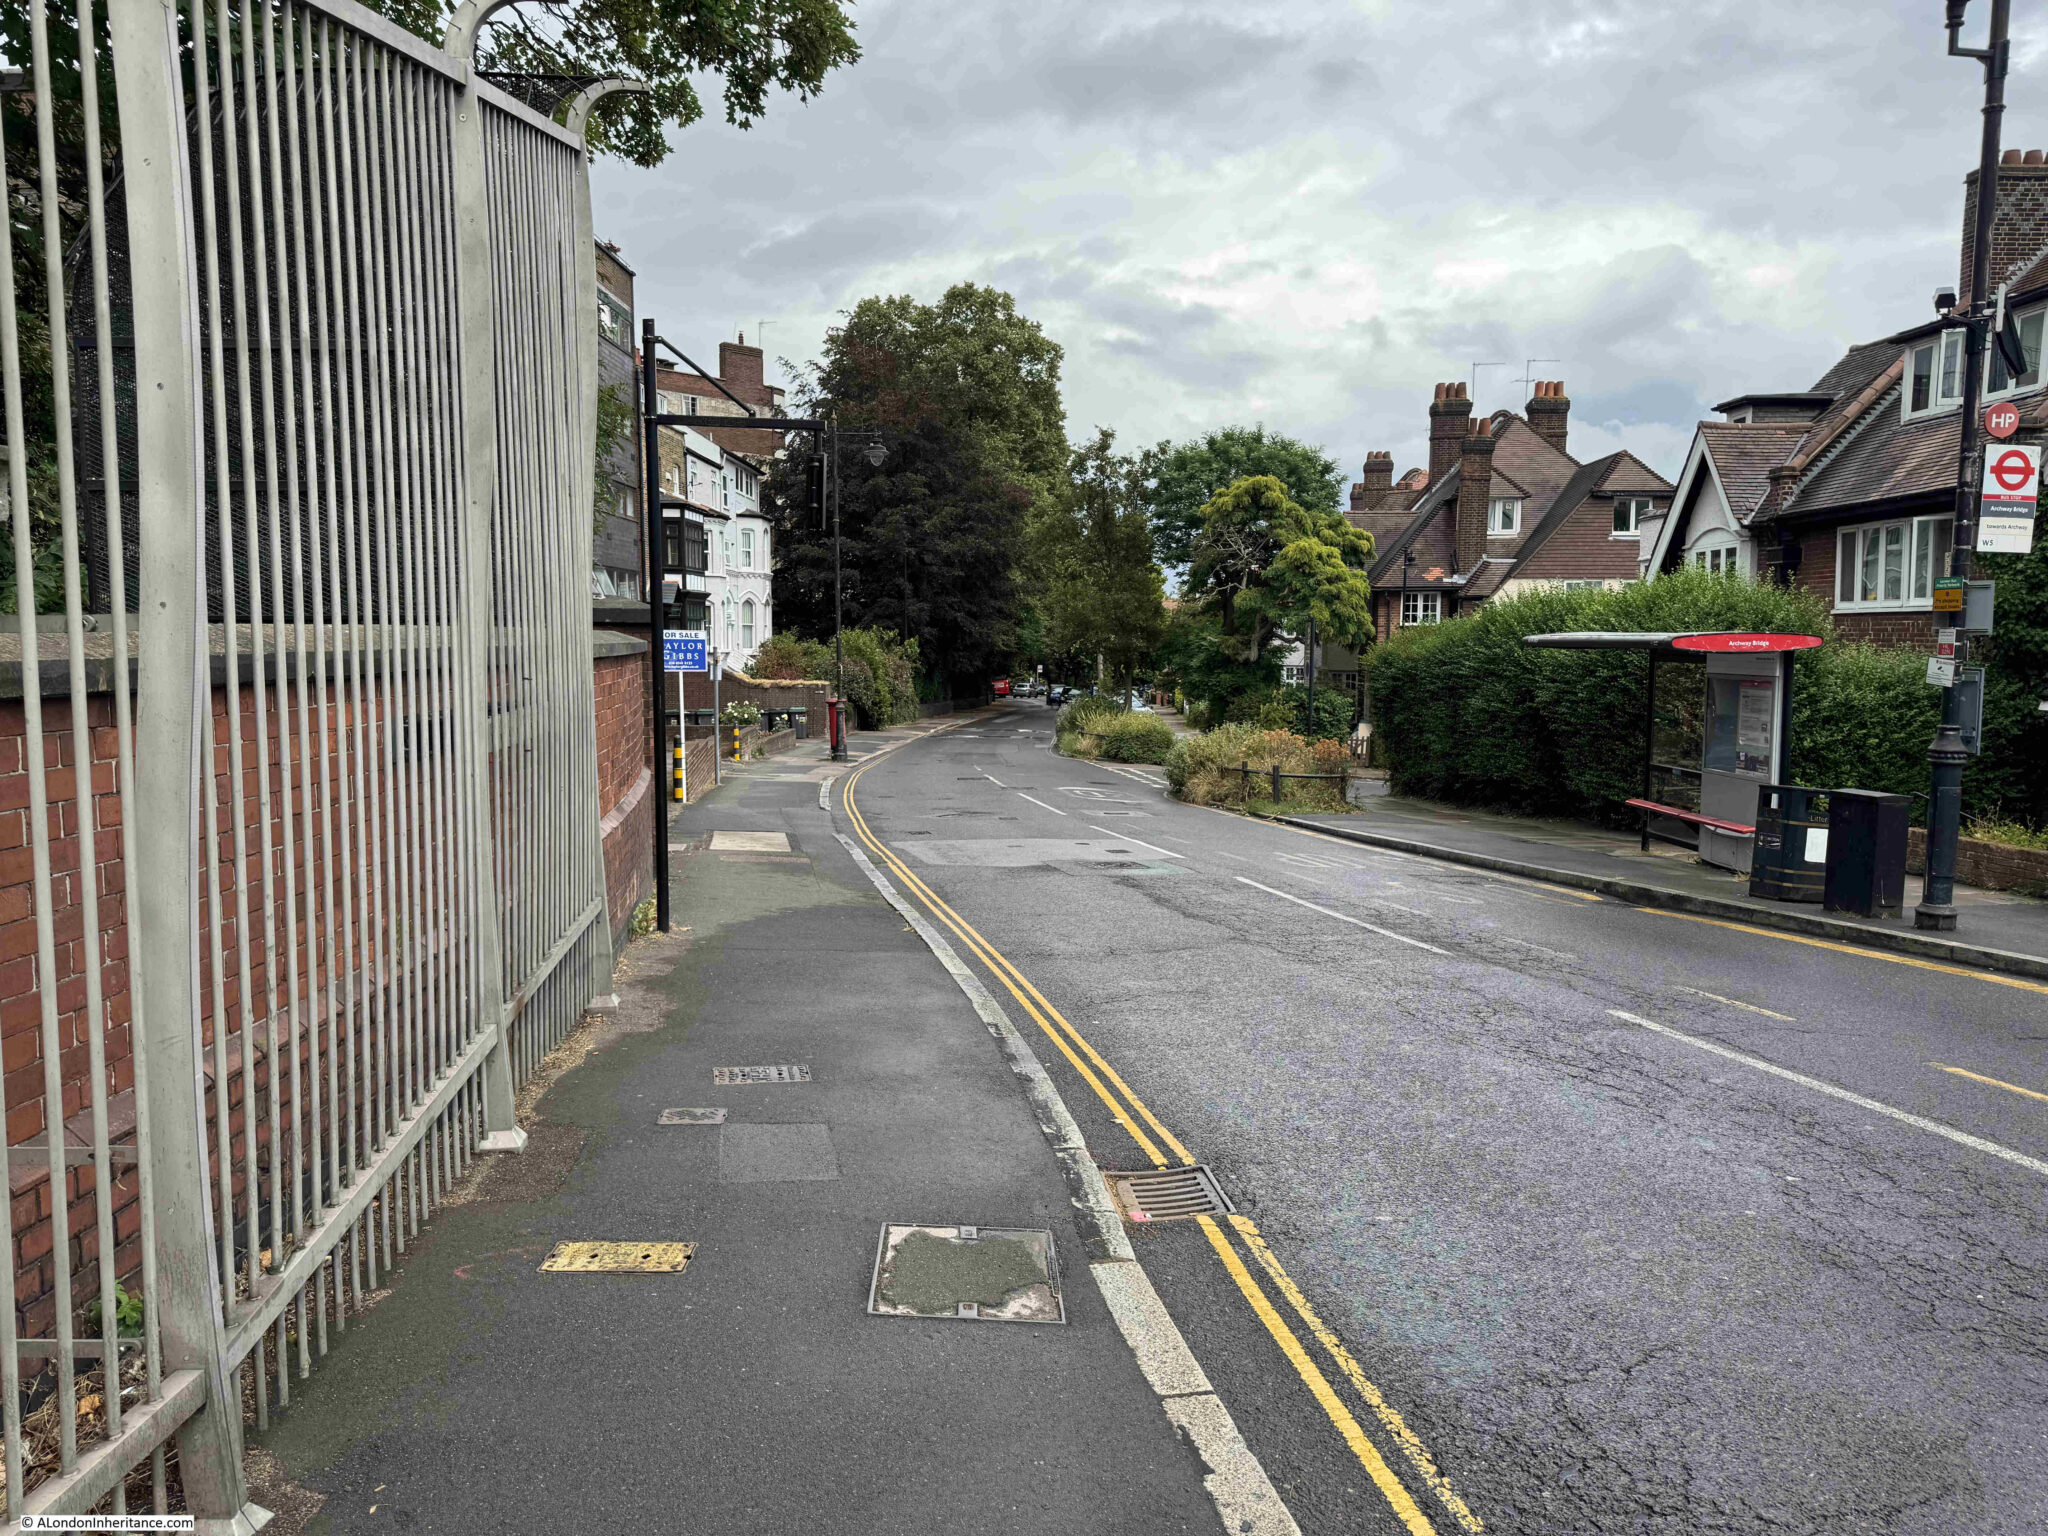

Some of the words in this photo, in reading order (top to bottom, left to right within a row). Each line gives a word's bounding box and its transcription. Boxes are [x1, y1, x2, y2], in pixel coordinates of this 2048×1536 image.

[1990, 413, 2015, 428] HP
[1990, 505, 2012, 513] Archway
[2013, 506, 2029, 514] Bridge
[1810, 815, 1828, 823] Litter
